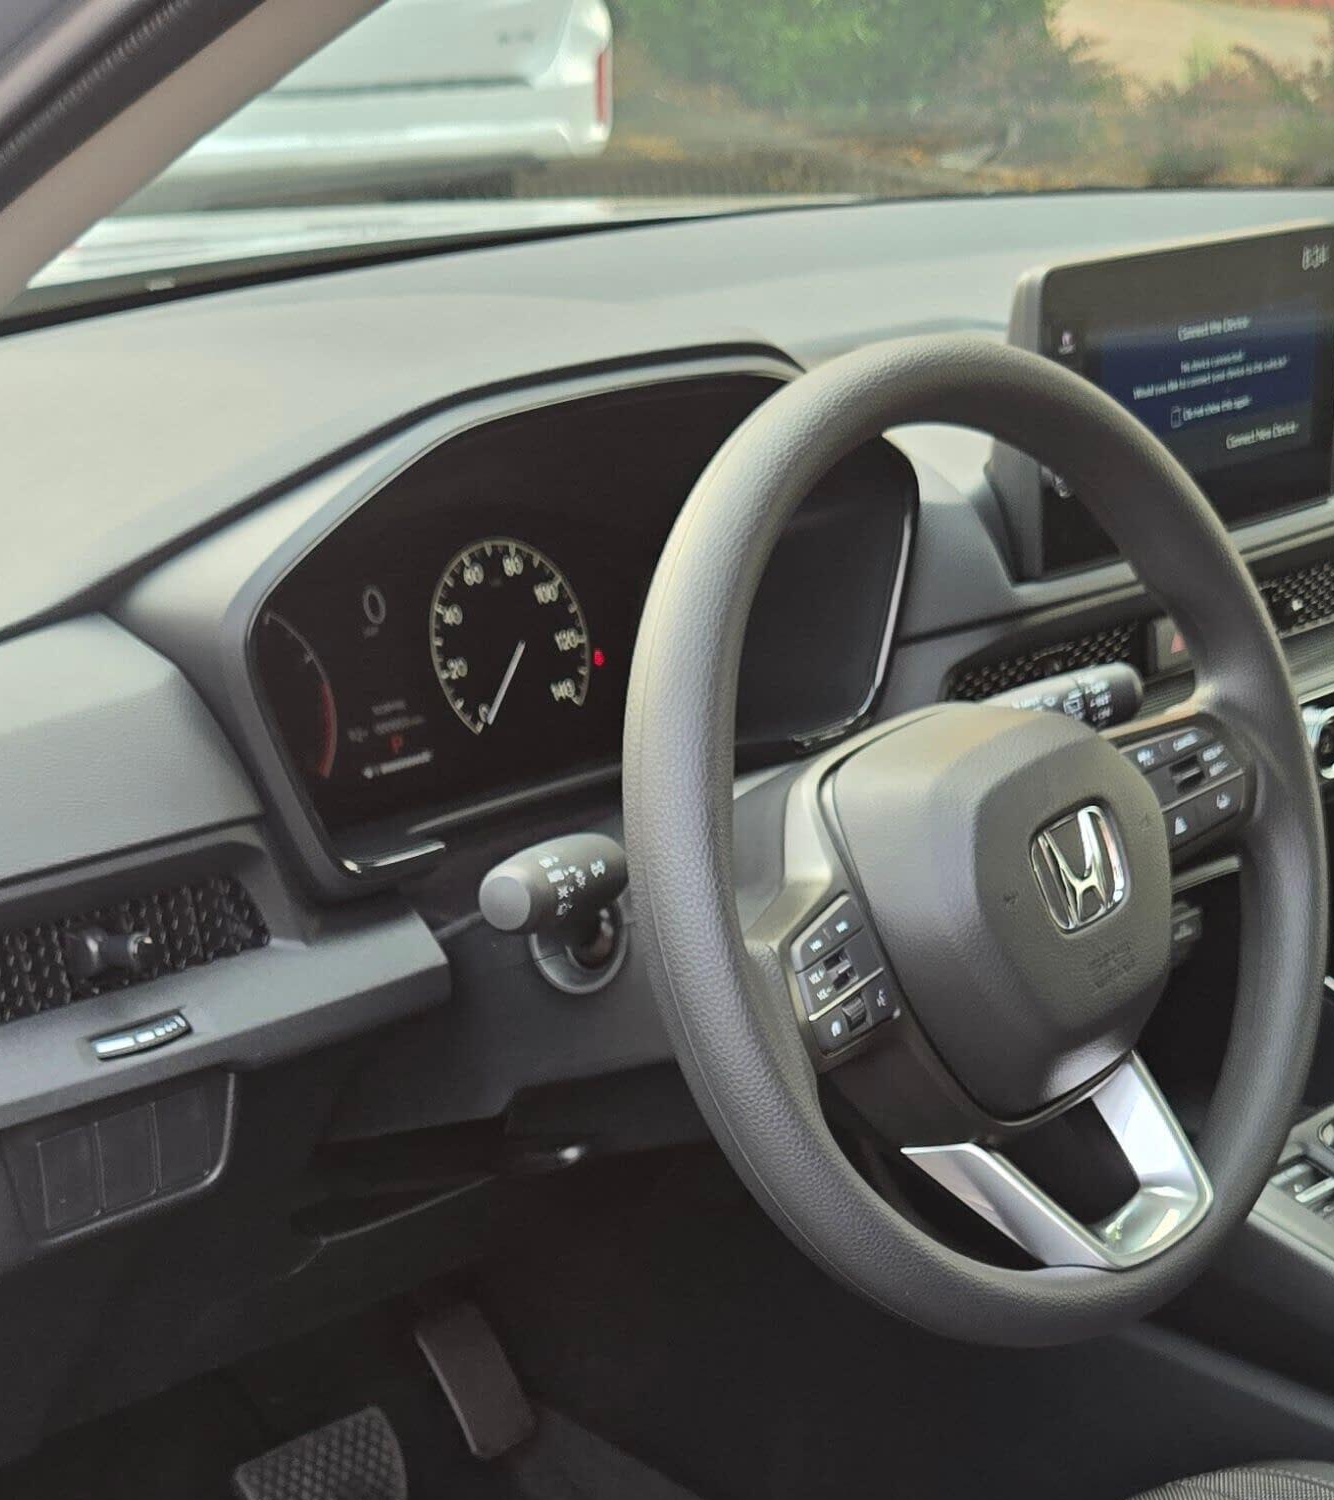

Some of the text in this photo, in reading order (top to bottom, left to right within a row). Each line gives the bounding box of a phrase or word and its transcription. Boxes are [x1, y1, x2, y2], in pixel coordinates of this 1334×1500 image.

[463, 566, 484, 586] 60
[503, 554, 524, 577] 80
[534, 582, 559, 605] 100
[442, 604, 463, 625] 40
[554, 628, 579, 651] 120
[447, 657, 468, 680] 20
[550, 678, 576, 701] 140
